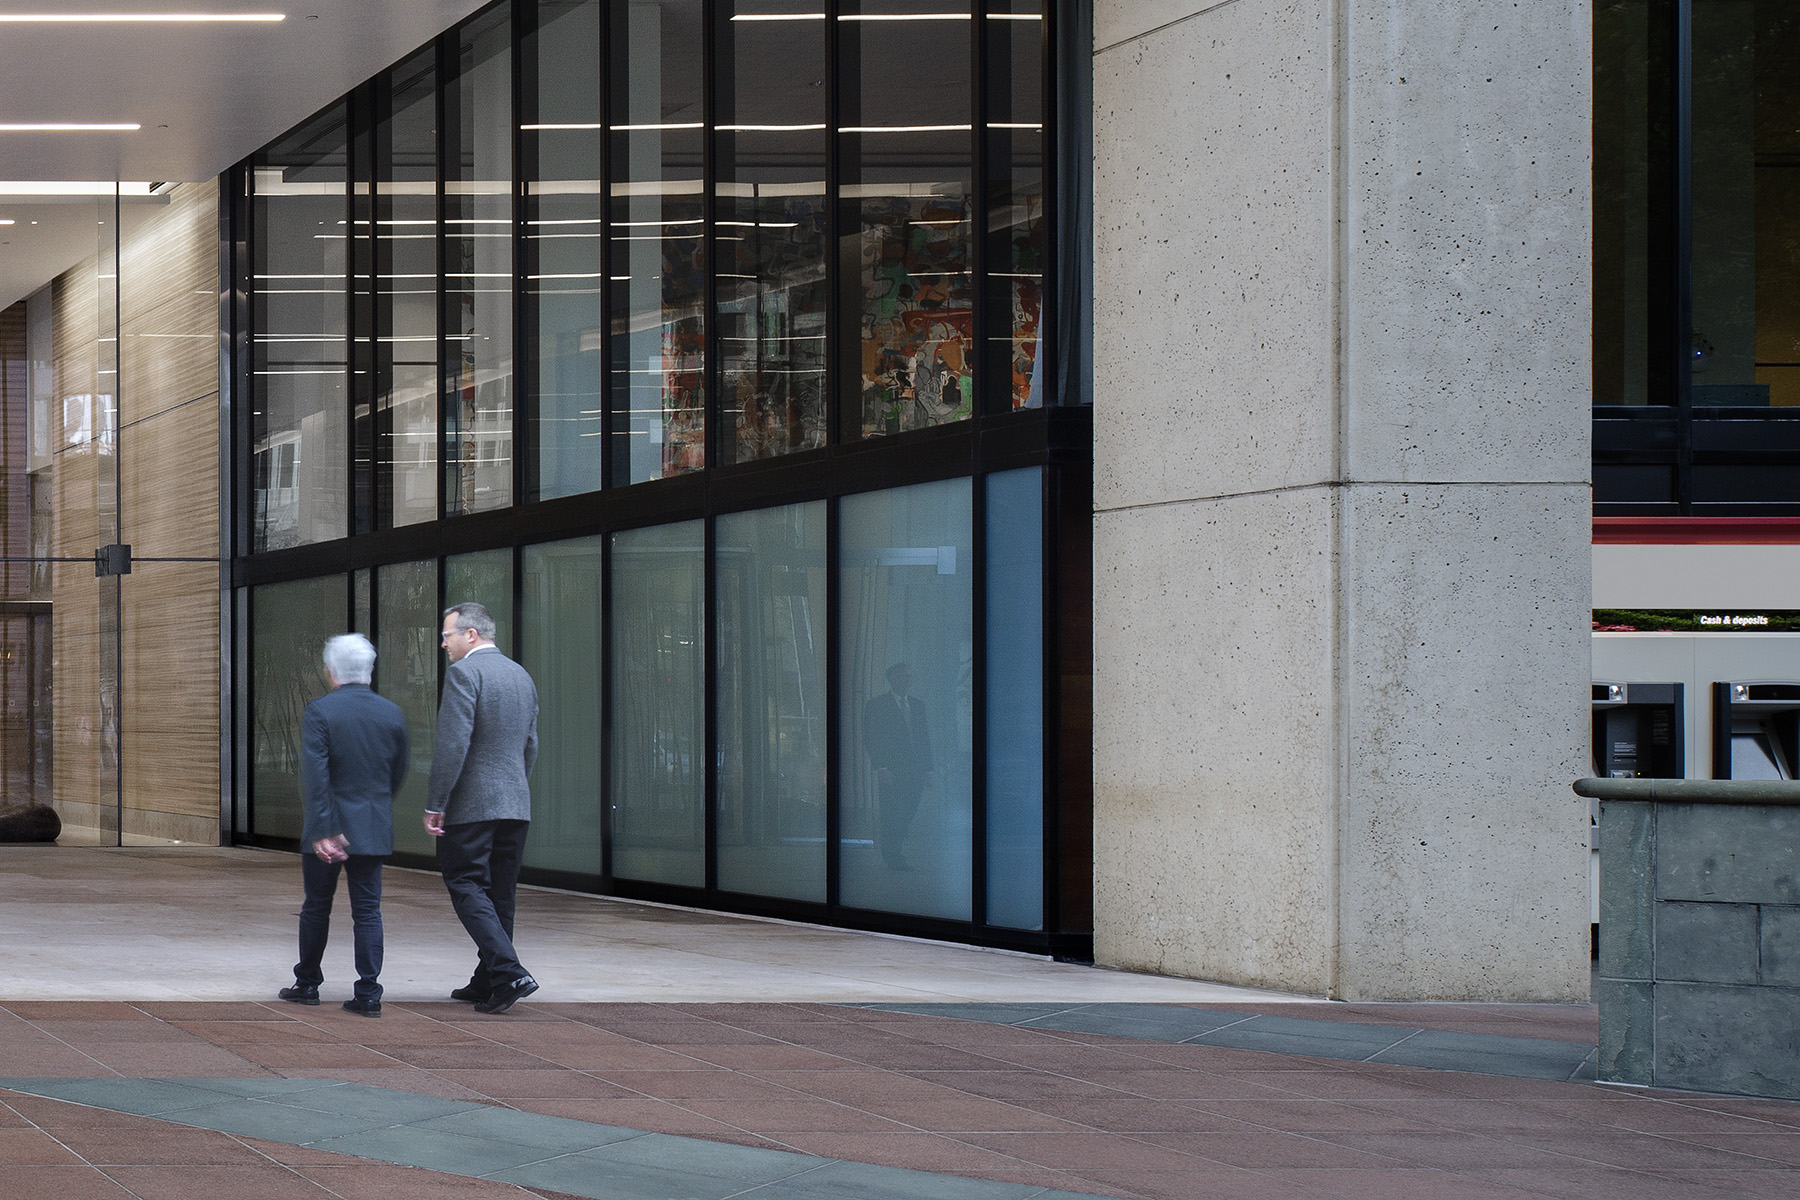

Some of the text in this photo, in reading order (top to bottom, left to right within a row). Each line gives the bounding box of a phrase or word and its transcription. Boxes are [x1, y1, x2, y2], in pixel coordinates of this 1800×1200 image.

[1700, 615, 1769, 626] Cash & deposits
